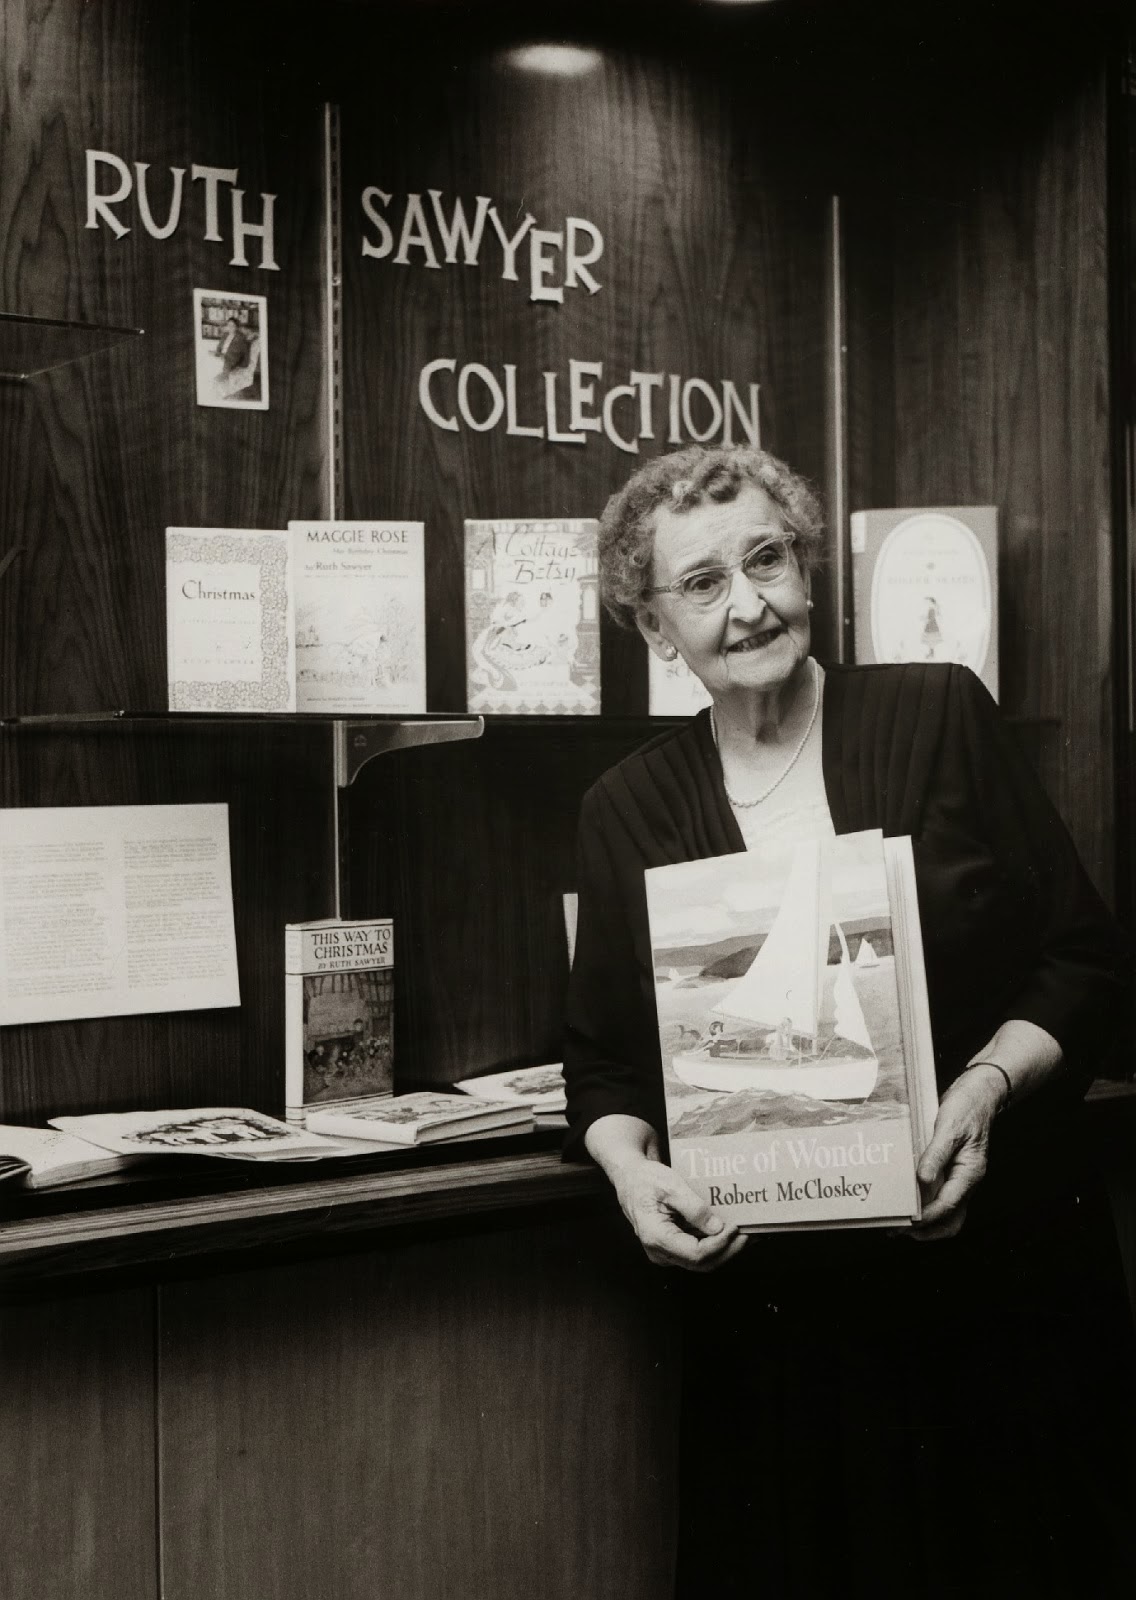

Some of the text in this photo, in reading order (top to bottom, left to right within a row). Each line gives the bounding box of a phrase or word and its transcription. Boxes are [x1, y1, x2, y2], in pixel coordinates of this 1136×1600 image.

[84, 149, 605, 303] RUTH SAWYER
[419, 358, 761, 454] COLLECTION
[306, 530, 409, 543] MAGGIE ROSE
[315, 562, 338, 570] Ruth
[182, 580, 255, 600] Christmas
[311, 929, 390, 945] THIS WAY TO
[314, 942, 387, 959] CHRISTMAS
[329, 960, 352, 969] RUTH
[355, 957, 386, 967] SAWYER
[683, 1132, 895, 1178] Time of Wonder
[708, 1176, 873, 1207] Robert McCloskey
